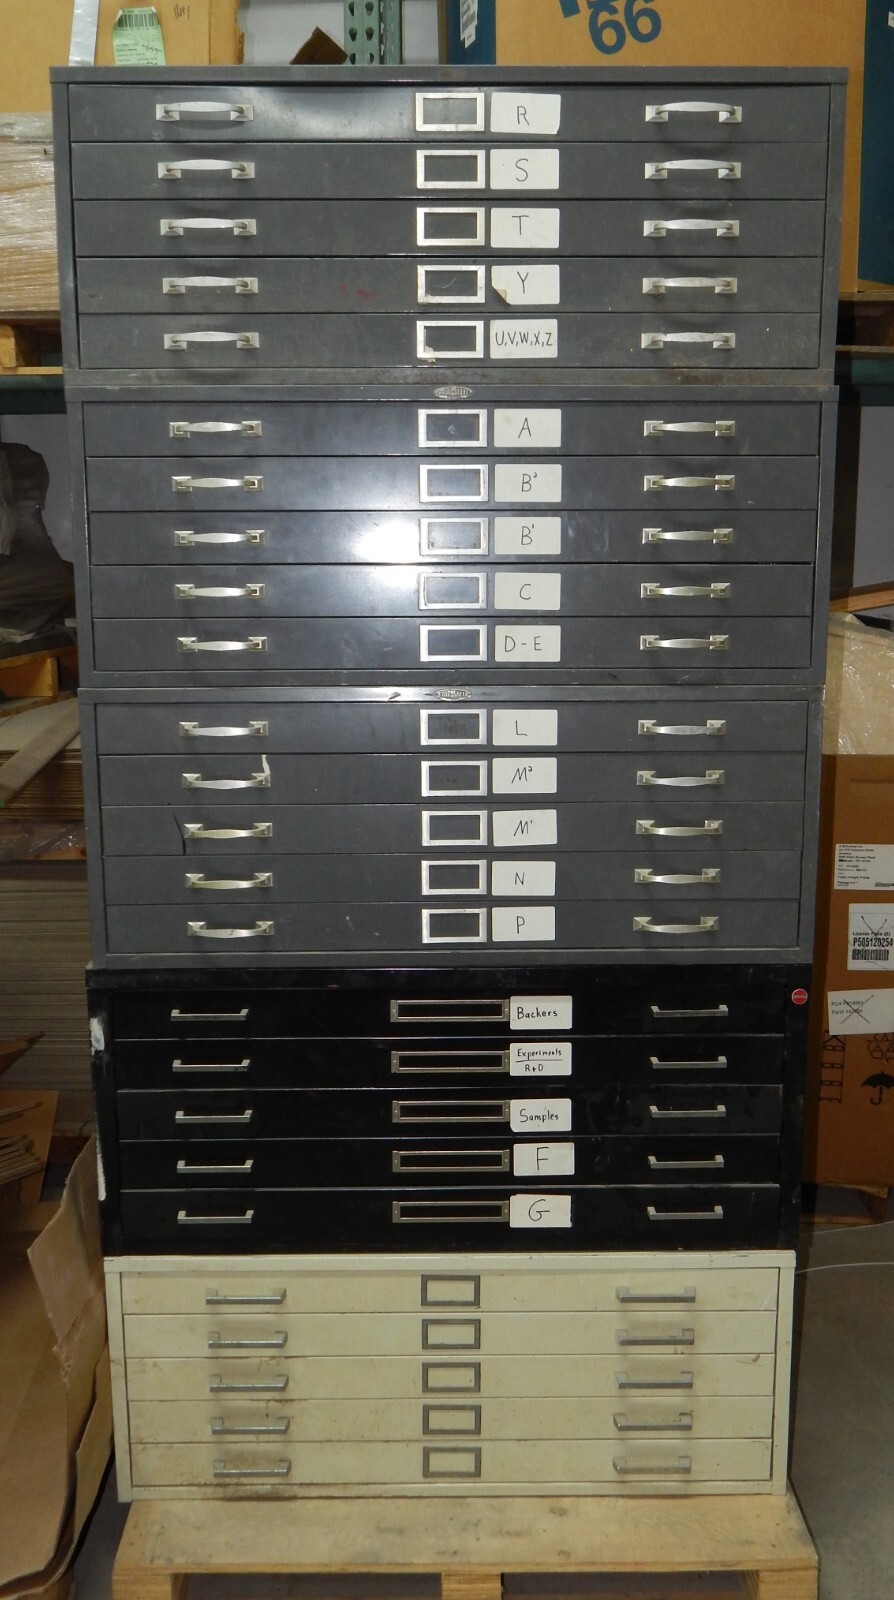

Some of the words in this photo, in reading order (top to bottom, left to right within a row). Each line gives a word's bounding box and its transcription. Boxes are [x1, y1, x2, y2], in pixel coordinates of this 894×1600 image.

[516, 105, 530, 126] R
[515, 158, 529, 182] S
[511, 215, 529, 236] T
[516, 271, 529, 294] Y
[517, 417, 532, 439] A
[519, 583, 532, 601] C
[515, 719, 528, 737] L
[514, 871, 525, 886] N
[516, 915, 526, 934] P
[853, 937, 893, 948] P505120254
[516, 1006, 558, 1020] Backers
[517, 1048, 562, 1060] Experiments
[519, 1108, 559, 1123] Samples
[536, 1146, 550, 1171] F
[528, 1198, 550, 1222] G
